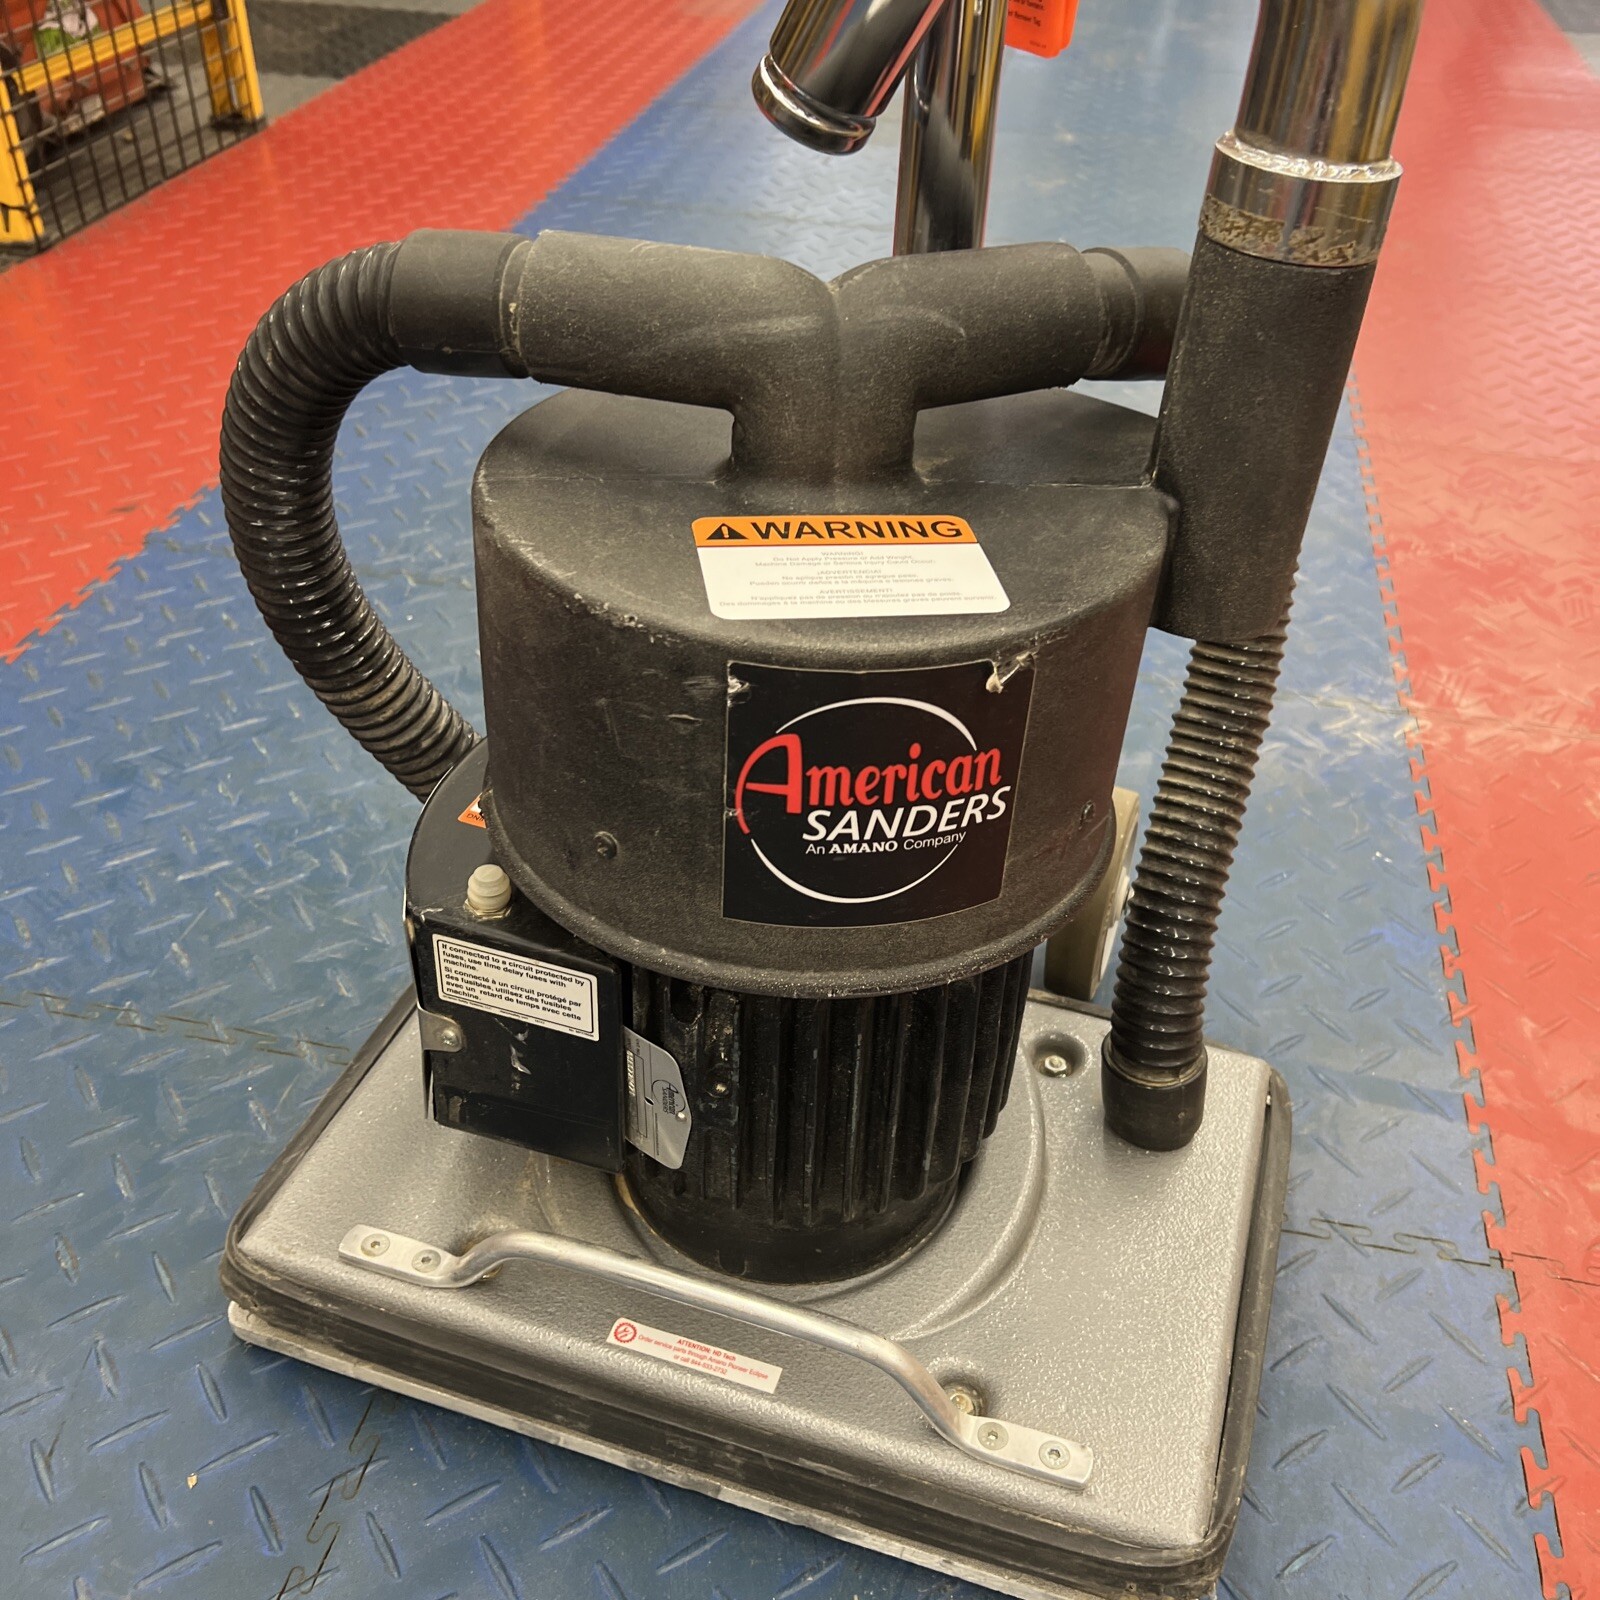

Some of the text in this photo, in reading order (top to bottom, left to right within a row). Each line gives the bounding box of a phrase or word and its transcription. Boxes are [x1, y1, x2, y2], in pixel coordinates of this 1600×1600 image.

[750, 520, 963, 540] WARNING
[735, 734, 1002, 834] American
[802, 786, 1011, 841] SANDERS
[805, 831, 967, 855] An AMANO Company
[449, 946, 490, 960] connected
[508, 961, 534, 972] circuit
[535, 968, 572, 982] protected
[575, 978, 584, 986] by
[484, 961, 501, 970] time
[503, 966, 523, 977] delay
[526, 972, 547, 982] fuses
[550, 979, 566, 988] with
[454, 970, 489, 982] connecté
[510, 984, 534, 994] circuit
[537, 991, 567, 1003] protégé
[496, 987, 523, 998] utilisez
[525, 994, 539, 1002] des
[541, 998, 572, 1011] fusibles
[480, 989, 502, 999] retard
[516, 999, 540, 1010] temps
[542, 1006, 560, 1014] avec
[562, 1011, 581, 1020] cette
[723, 1353, 736, 1361] Tech
